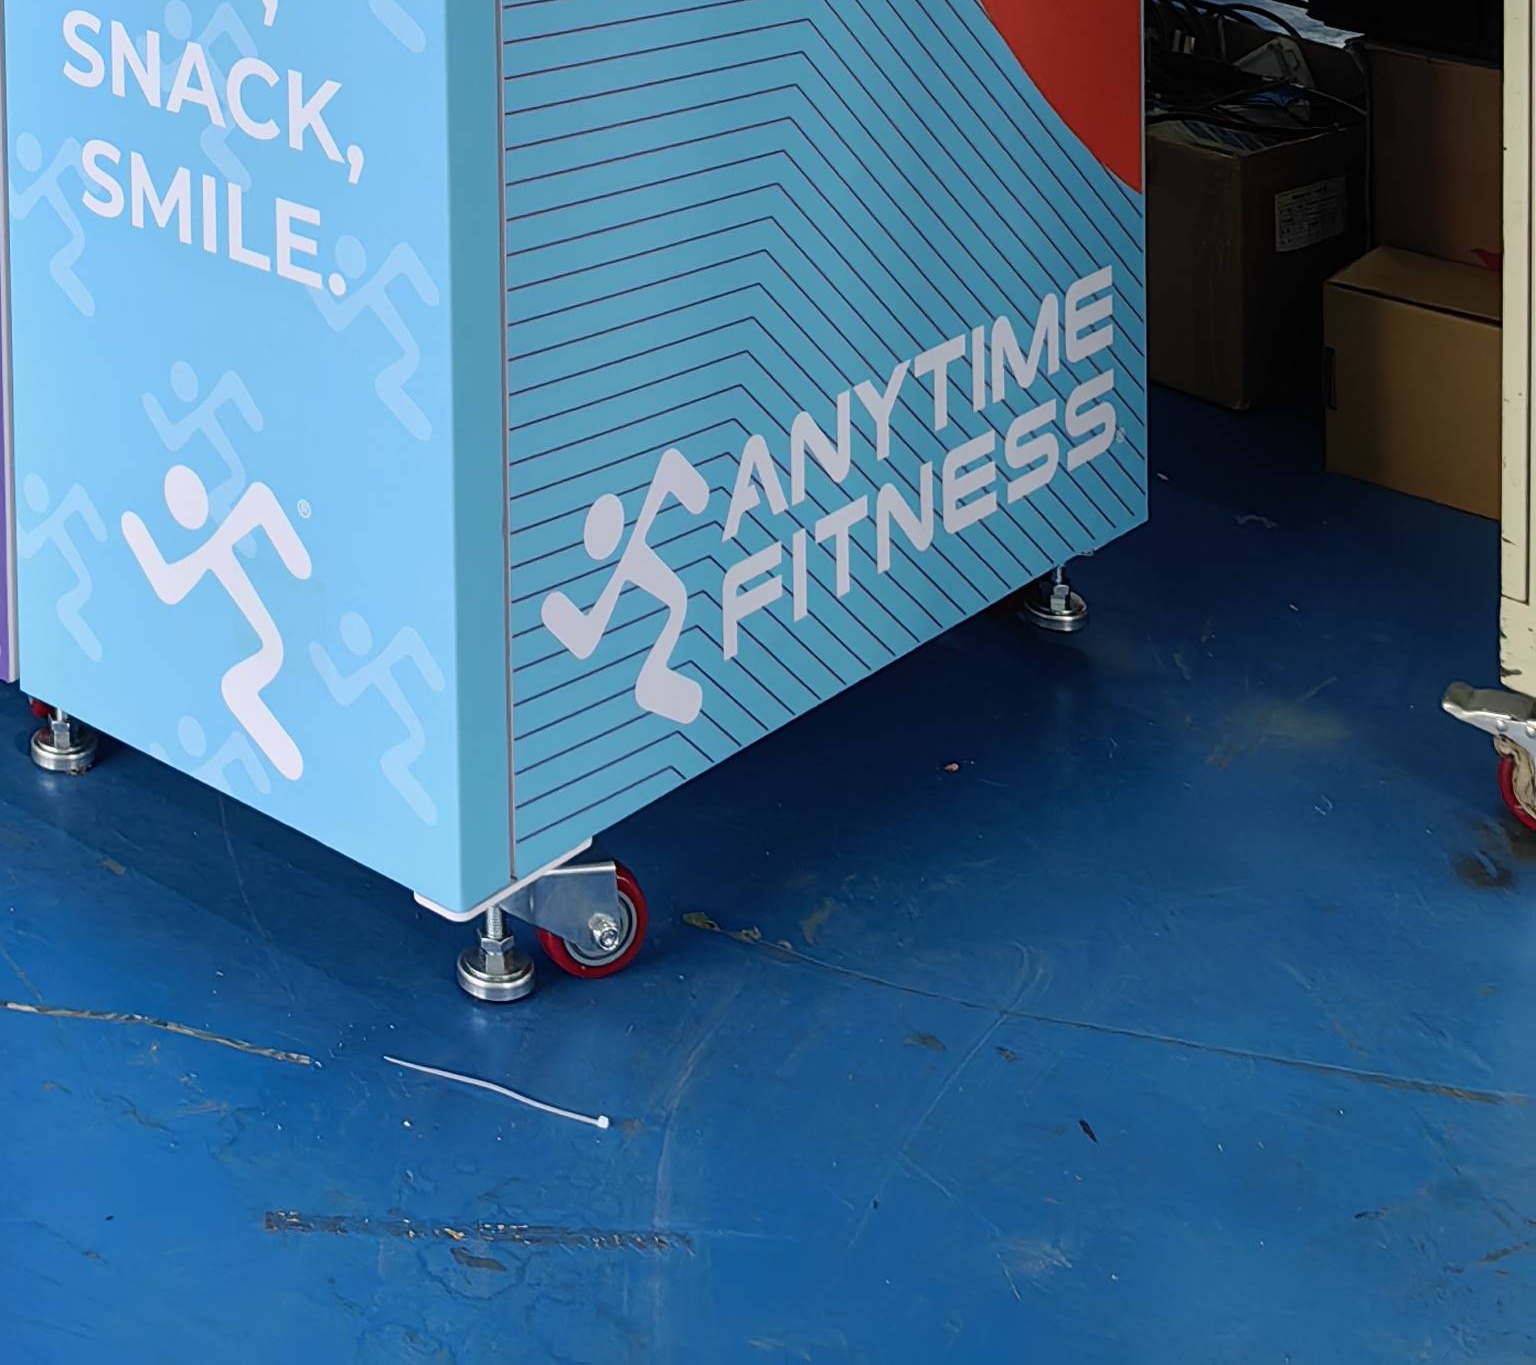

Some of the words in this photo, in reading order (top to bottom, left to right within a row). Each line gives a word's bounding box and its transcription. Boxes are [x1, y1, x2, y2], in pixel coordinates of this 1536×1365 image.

[63, 10, 364, 184] SNACK,
[81, 139, 346, 296] SMILE.
[722, 265, 1113, 543] ANYTIME
[722, 369, 1116, 661] FITNESS
